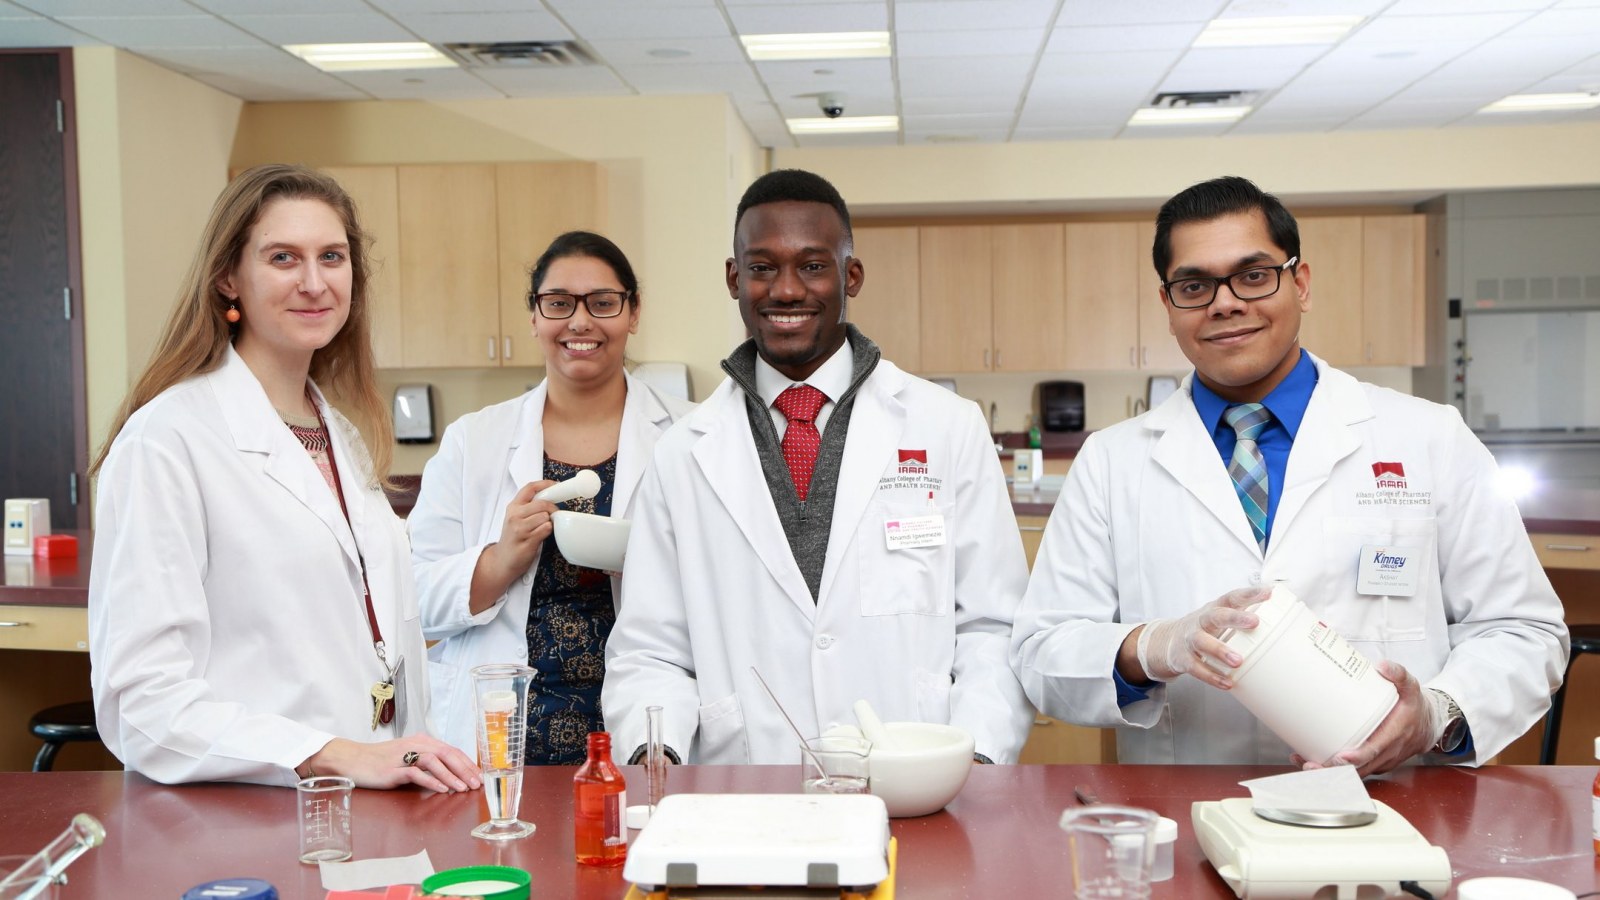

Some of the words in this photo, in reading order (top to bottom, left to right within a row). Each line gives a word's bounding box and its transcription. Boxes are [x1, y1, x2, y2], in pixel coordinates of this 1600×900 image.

[897, 475, 915, 484] College
[1376, 490, 1394, 499] College
[1402, 491, 1432, 499] Pharmacy
[1373, 552, 1407, 568] Kinney
